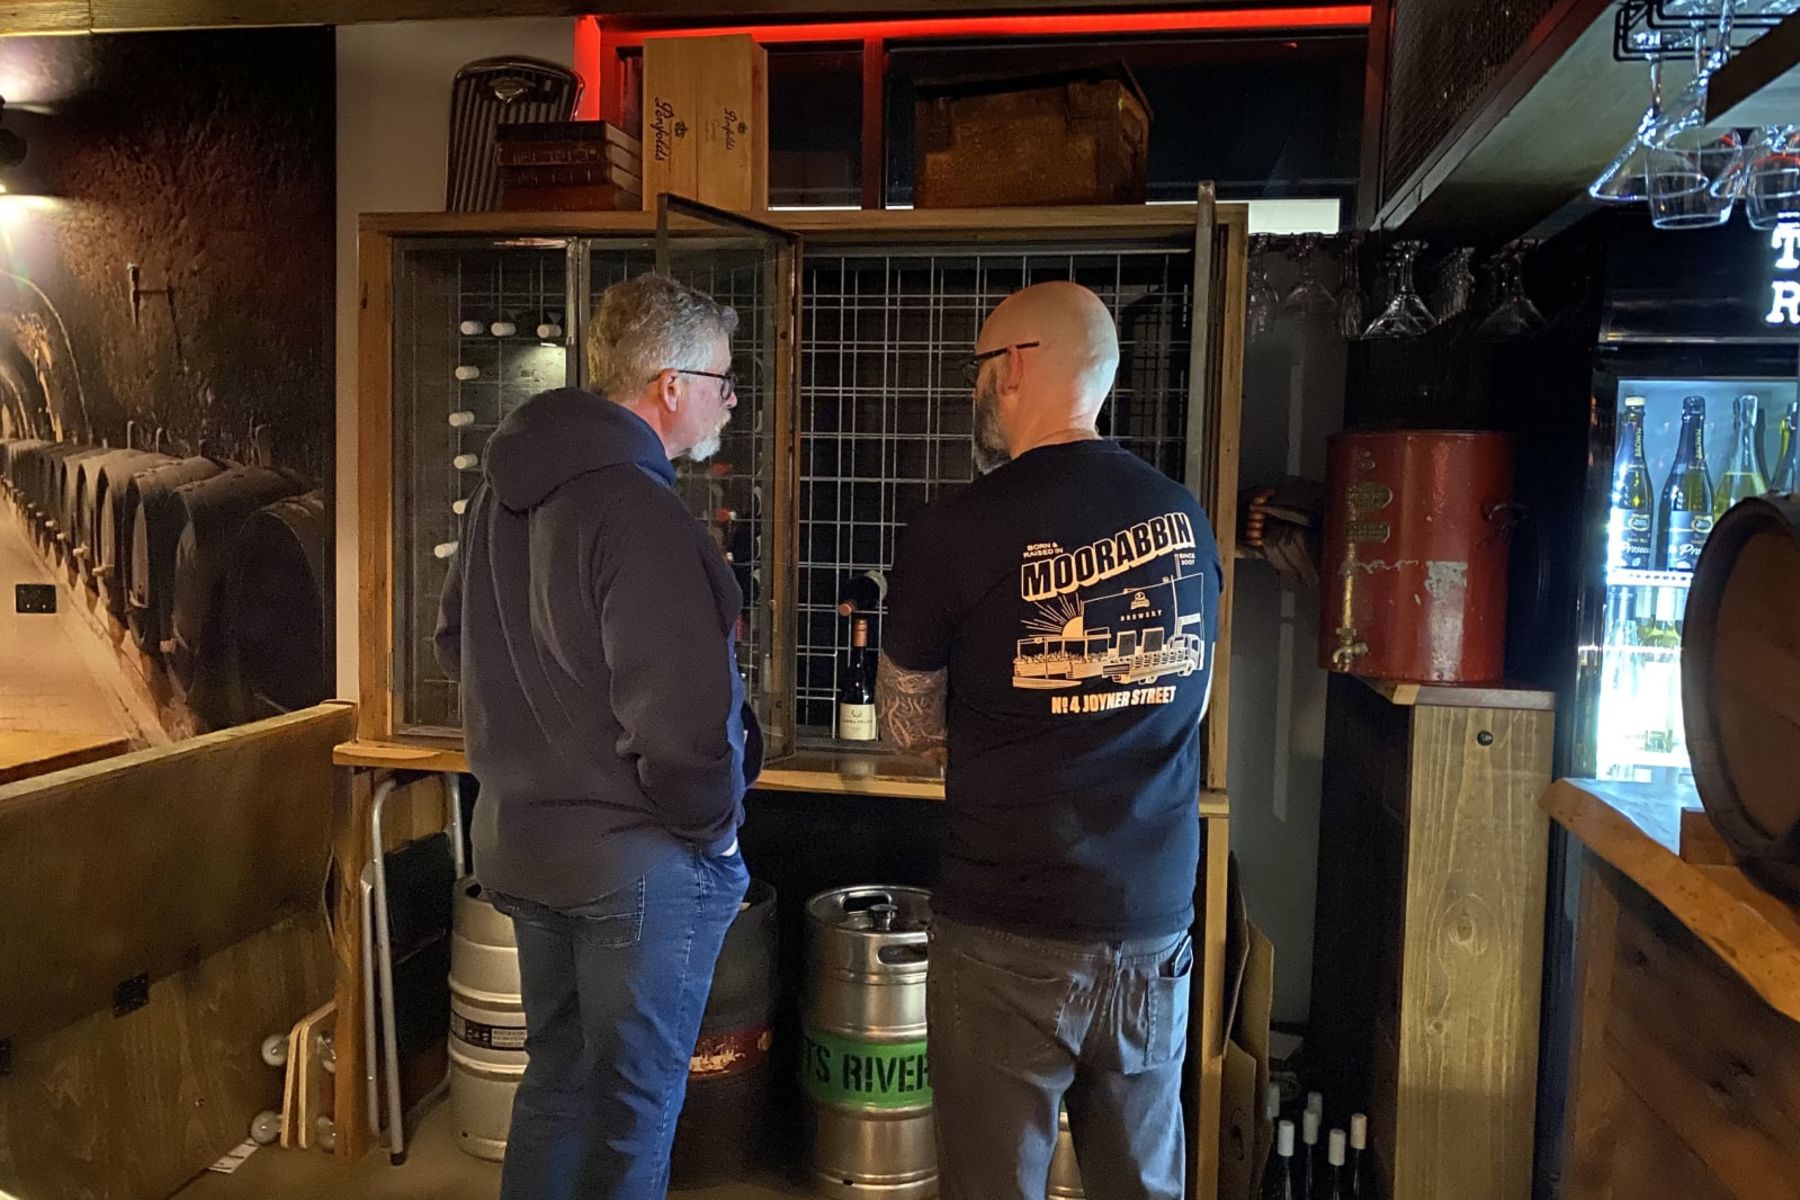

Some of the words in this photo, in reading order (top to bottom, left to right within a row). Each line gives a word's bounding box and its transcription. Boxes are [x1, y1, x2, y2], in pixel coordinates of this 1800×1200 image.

[650, 97, 674, 161] Penfolds
[1021, 511, 1196, 602] MOORABBIN
[1022, 548, 1054, 558] RAISED
[1026, 543, 1051, 551] BORN
[1120, 609, 1162, 622] BREWERY
[1070, 695, 1080, 713] 4
[1082, 690, 1130, 713] JOYNER
[1131, 685, 1177, 706] STREET
